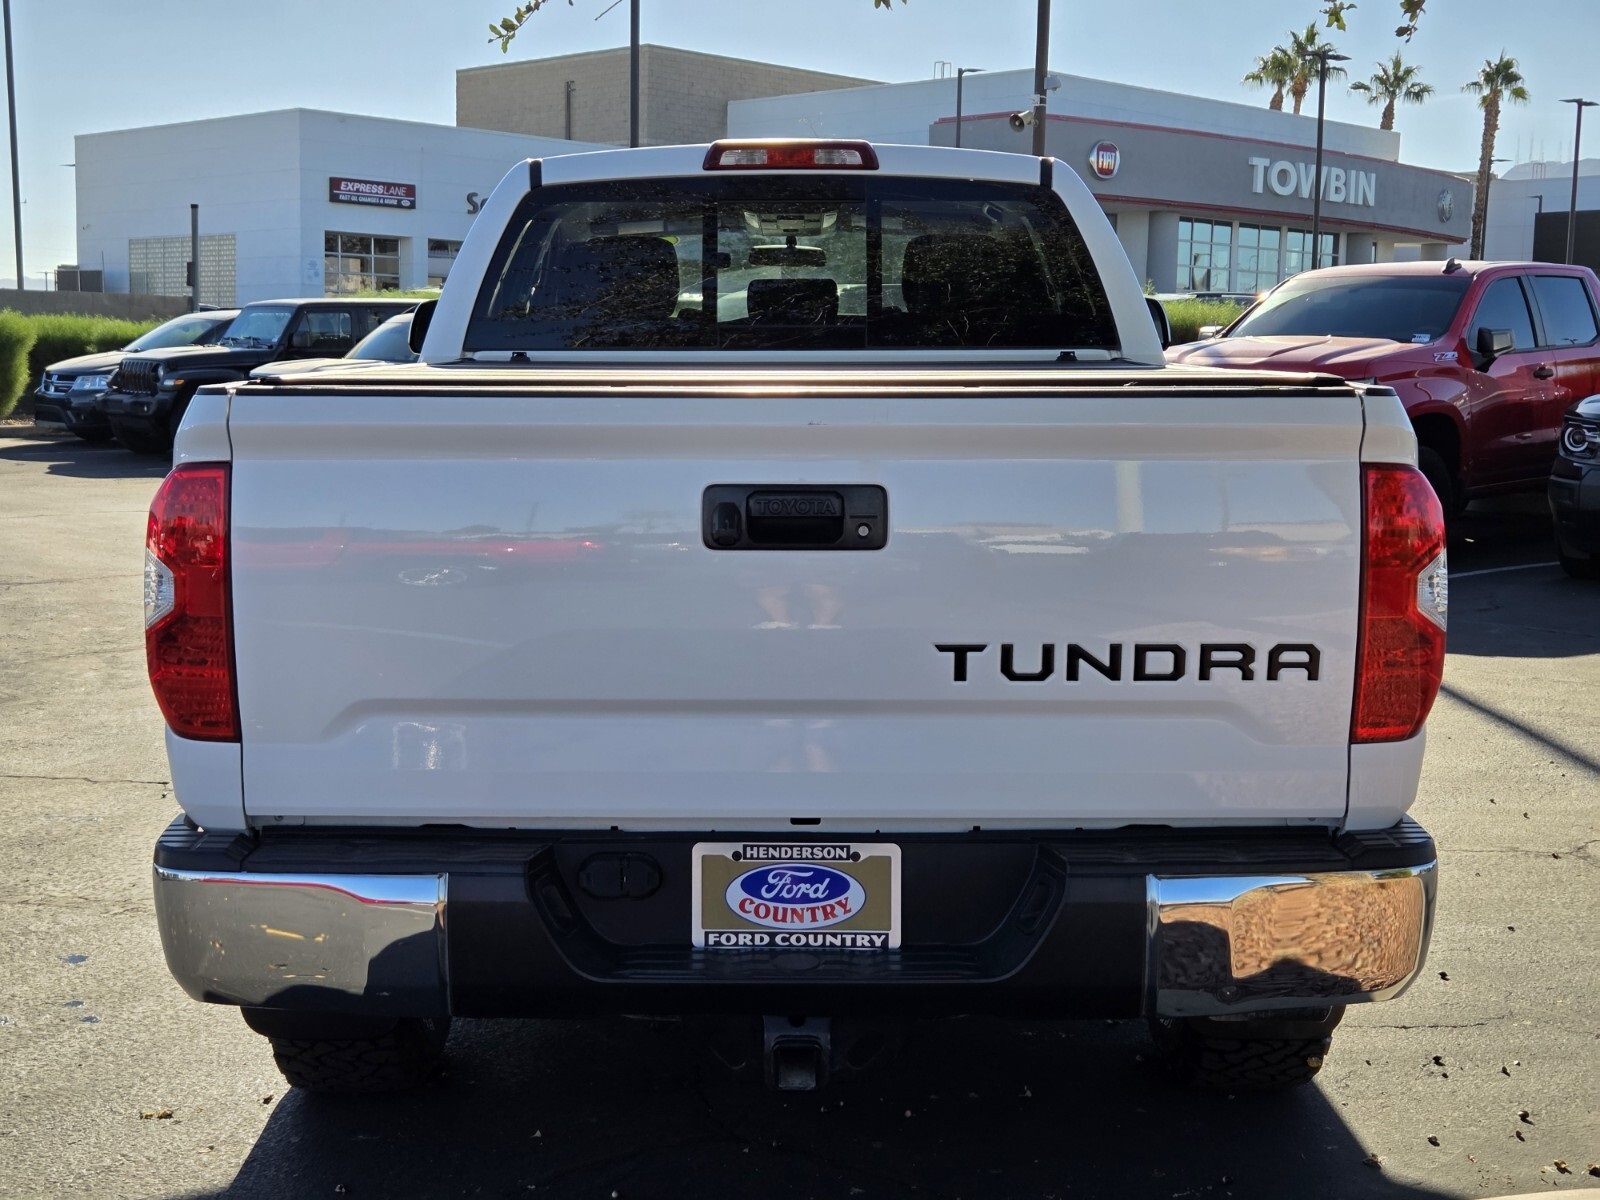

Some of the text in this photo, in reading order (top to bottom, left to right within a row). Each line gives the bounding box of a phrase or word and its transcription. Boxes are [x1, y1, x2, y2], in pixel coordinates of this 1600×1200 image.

[1098, 150, 1116, 170] FIAT
[1248, 155, 1377, 207] TOWBIN
[466, 191, 489, 215] S
[756, 499, 836, 516] TOYOTA
[933, 643, 1321, 682] TUNDRA
[746, 846, 847, 860] HENDERSON
[760, 869, 831, 899] Ford
[738, 896, 852, 924] COUNTRY
[708, 933, 887, 948] FORD COUNTRY
